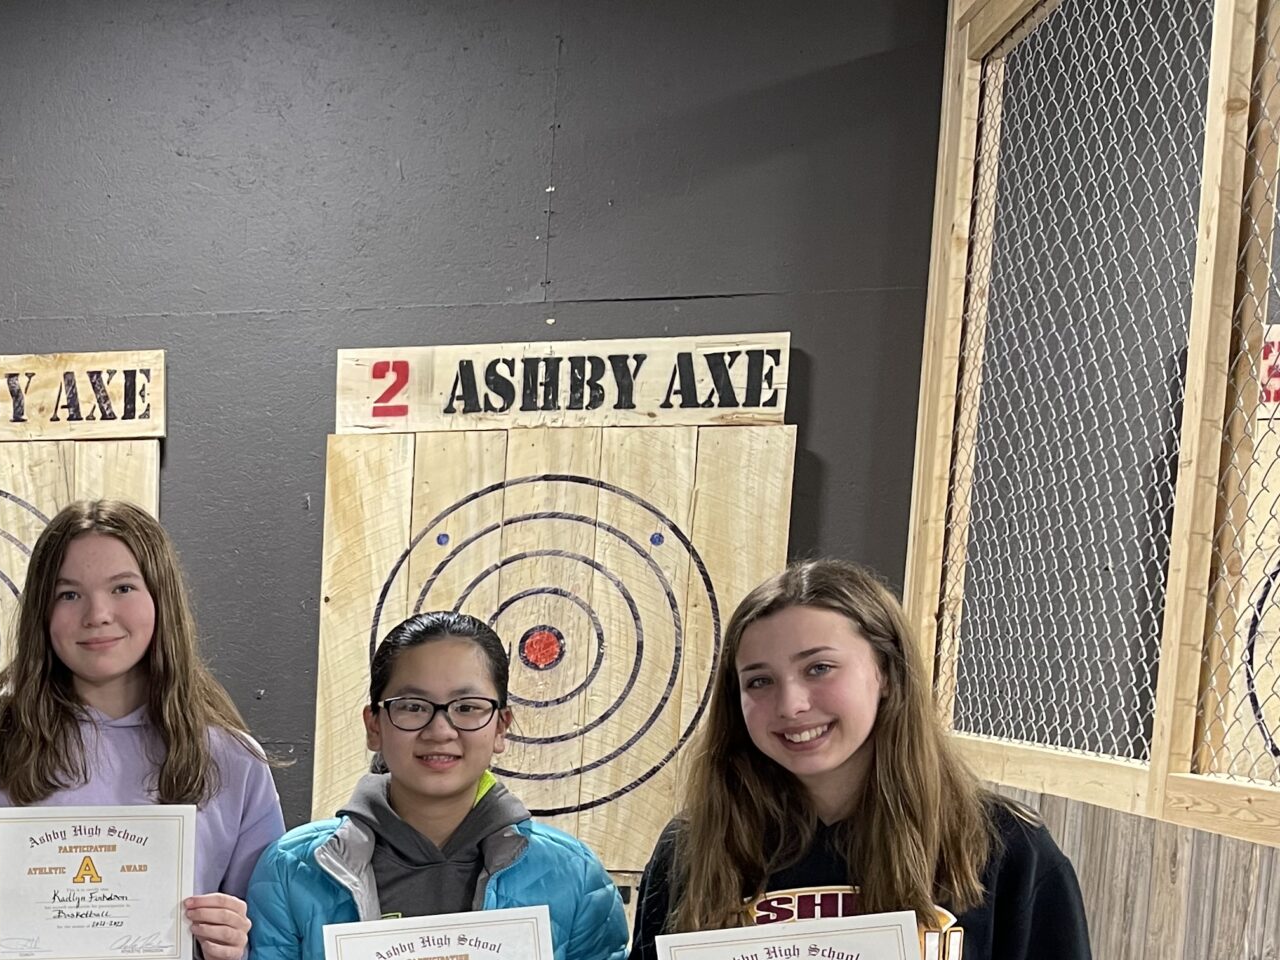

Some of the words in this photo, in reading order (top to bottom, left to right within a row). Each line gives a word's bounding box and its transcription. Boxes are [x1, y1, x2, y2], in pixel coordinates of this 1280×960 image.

[372, 360, 410, 418] 2
[443, 354, 647, 415] ASHBY
[660, 349, 781, 409] AXE
[50, 368, 152, 422] AXE
[29, 830, 67, 848] Ashby
[72, 825, 101, 837] High
[107, 825, 149, 846] School
[58, 844, 117, 854] PARTICIPATION
[27, 867, 66, 875] ATHLETIC
[120, 864, 148, 873] AWARD
[73, 856, 102, 883] A
[419, 935, 451, 948] High
[457, 934, 502, 954] School
[763, 945, 800, 960] High
